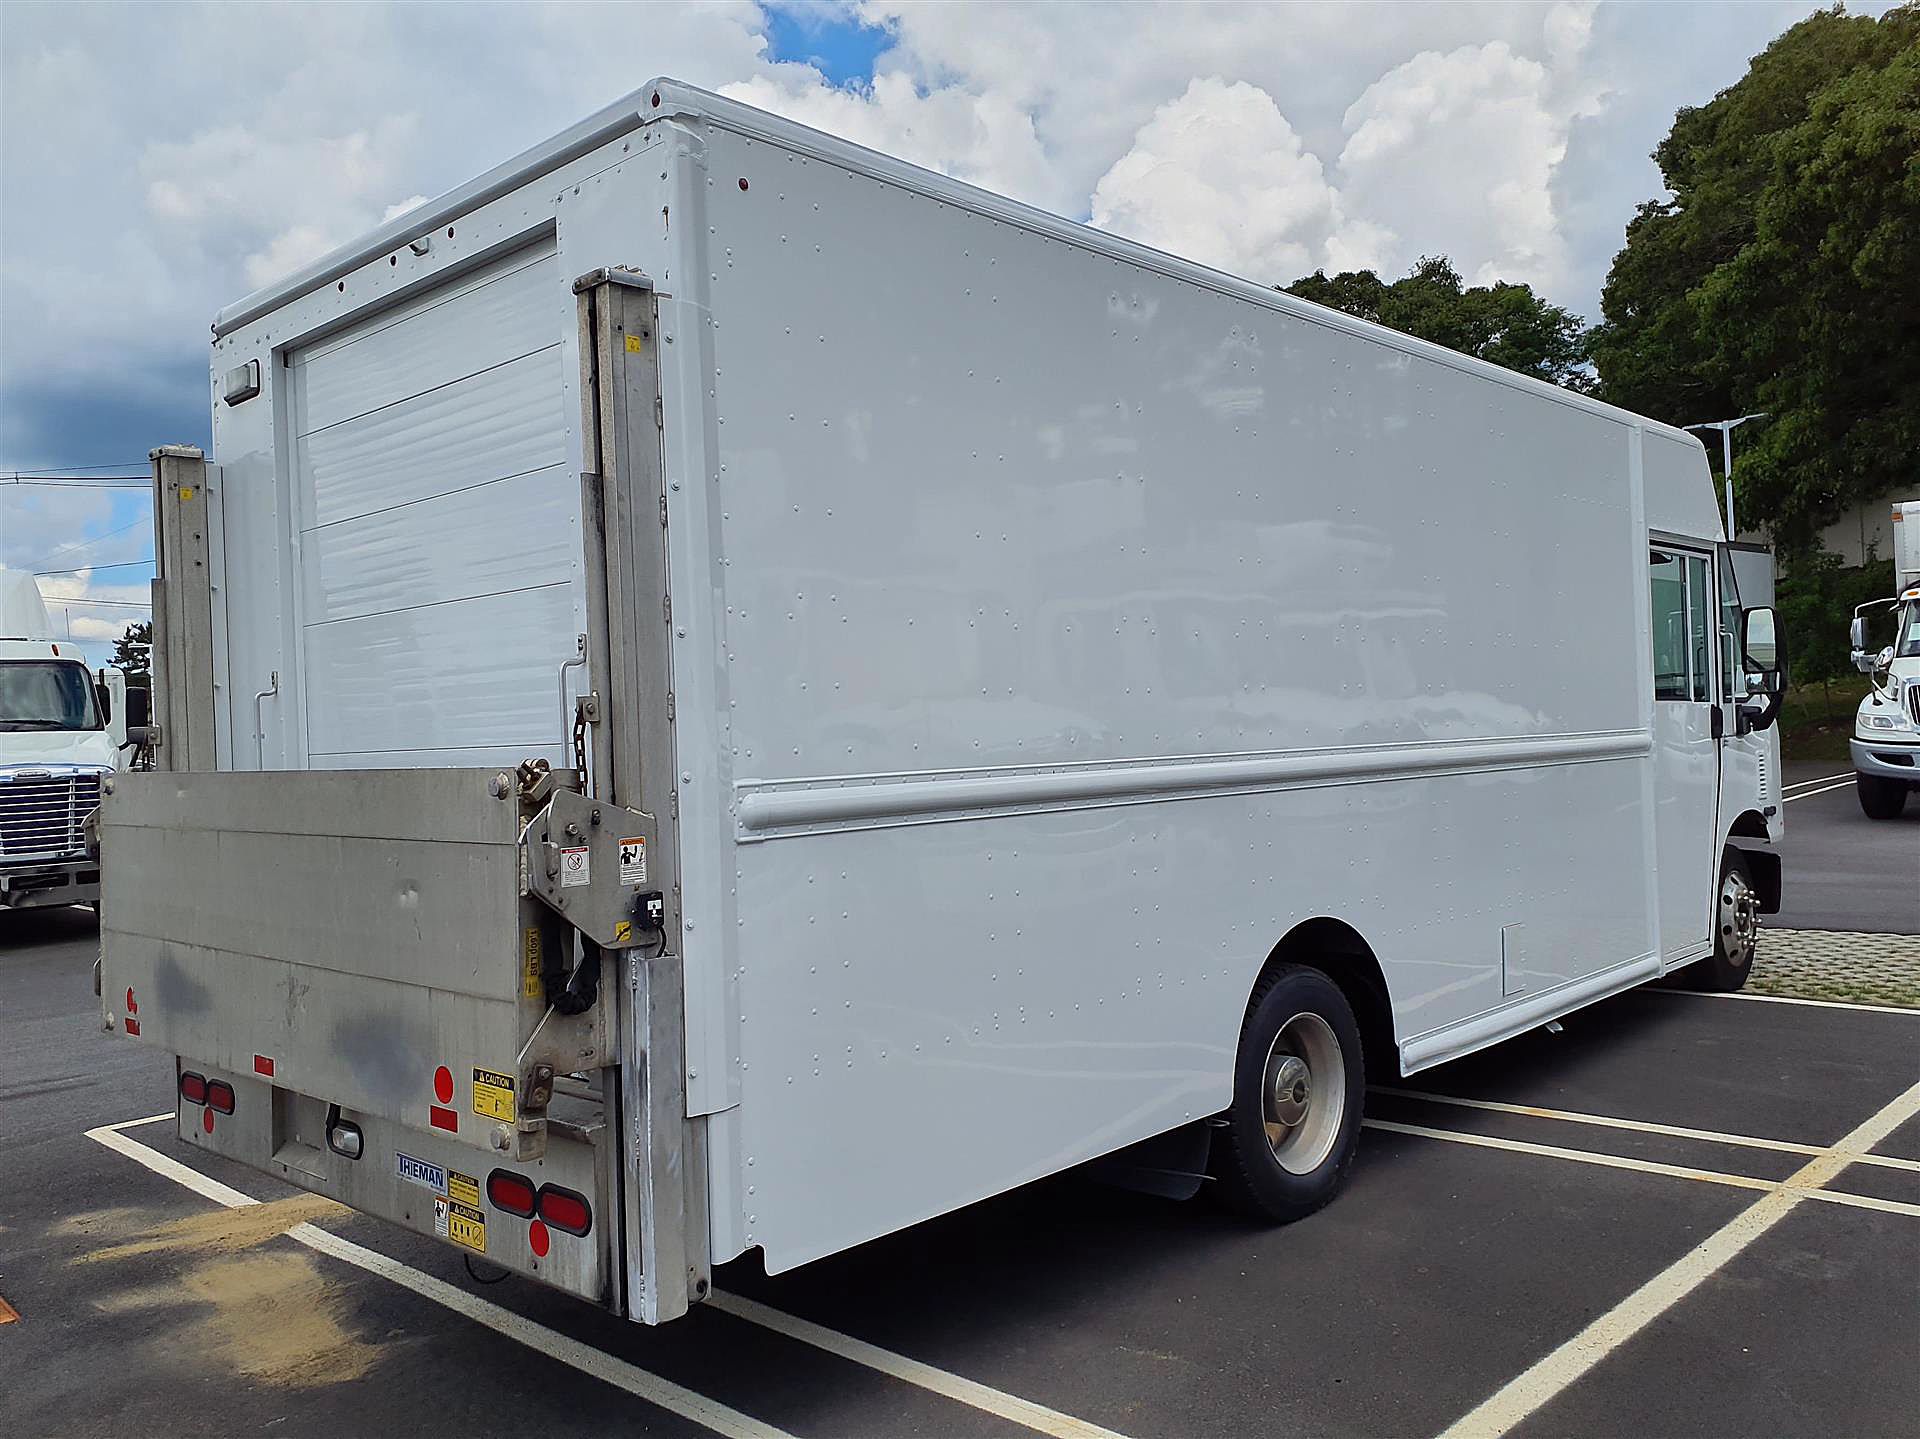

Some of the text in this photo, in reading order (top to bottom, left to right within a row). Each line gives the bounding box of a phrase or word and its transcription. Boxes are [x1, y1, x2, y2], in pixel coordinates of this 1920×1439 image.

[530, 957, 538, 976] LBS
[485, 1073, 510, 1089] CAUTION
[397, 1152, 443, 1188] THIEMAN
[457, 1173, 475, 1185] CAUTION
[459, 1208, 480, 1221] CAUTION
